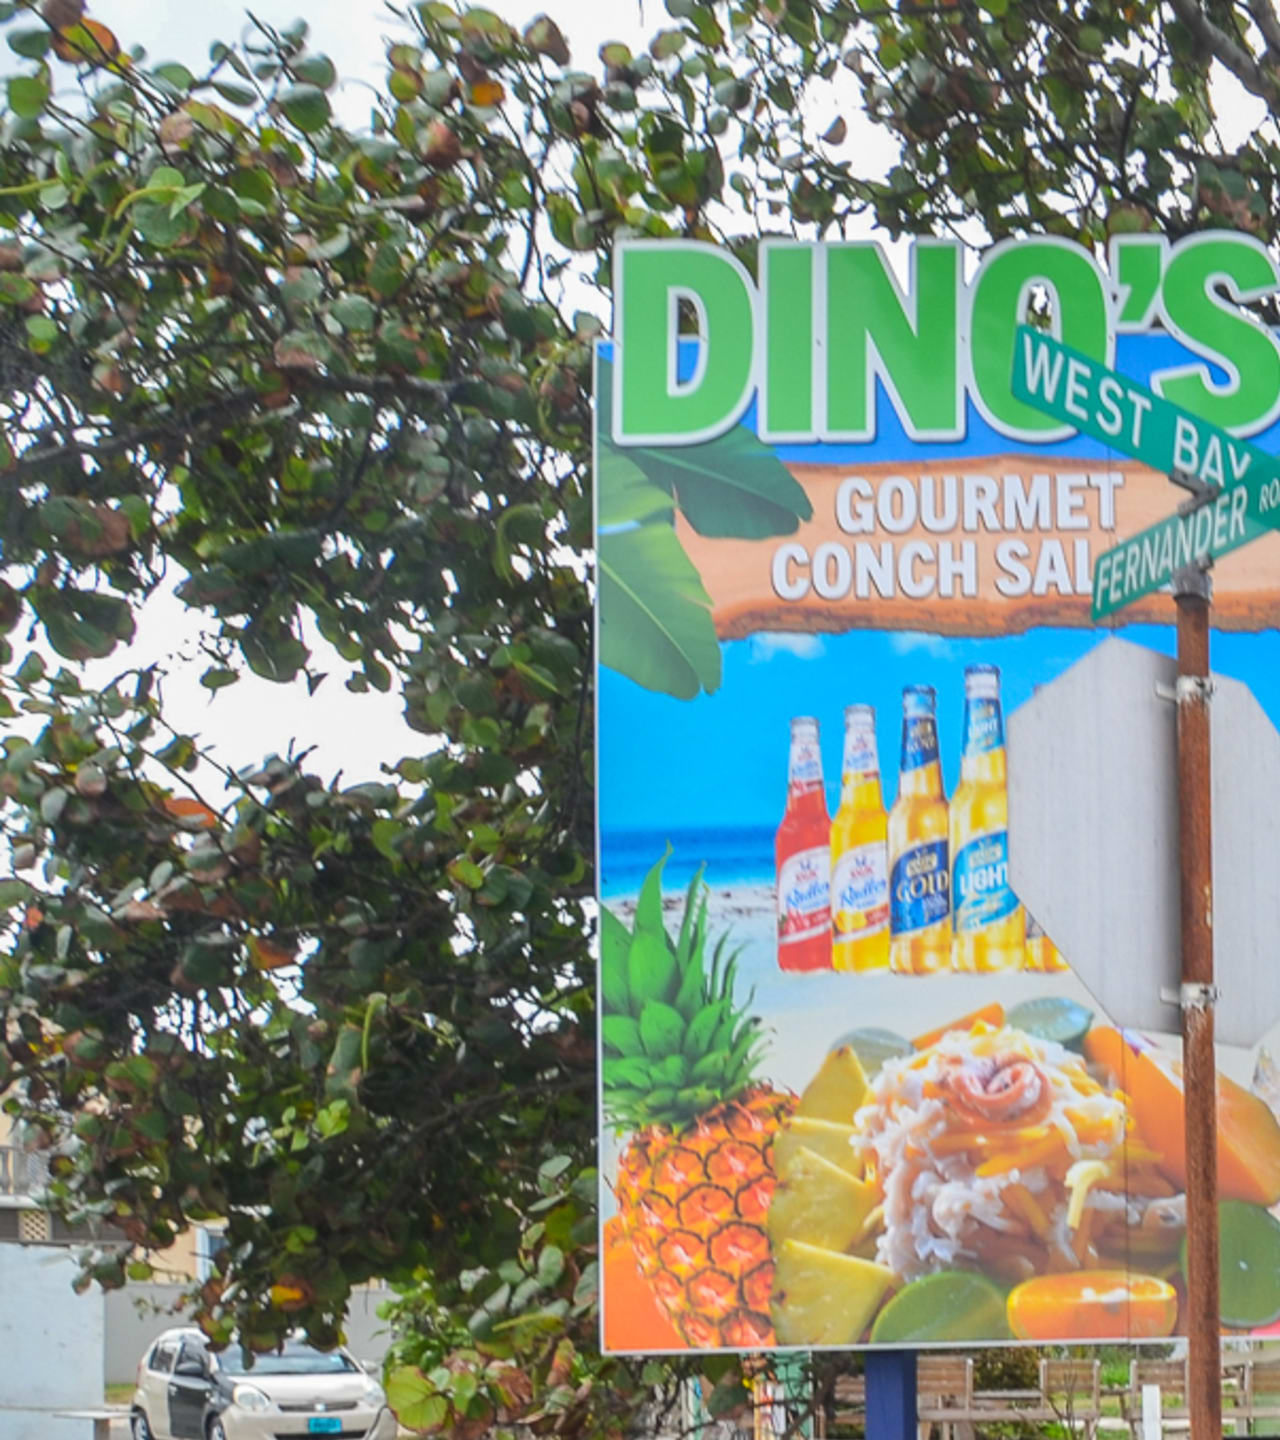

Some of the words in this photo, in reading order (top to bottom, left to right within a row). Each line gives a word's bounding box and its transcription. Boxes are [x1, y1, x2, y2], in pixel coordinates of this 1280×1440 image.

[1023, 332, 1152, 448] WEST
[1173, 414, 1251, 488] BAY
[834, 471, 1124, 534] GOURMET
[770, 540, 978, 600] CONCH
[994, 537, 1096, 597] SAL
[1095, 485, 1249, 610] FERNANDER
[896, 870, 949, 903] GOLD
